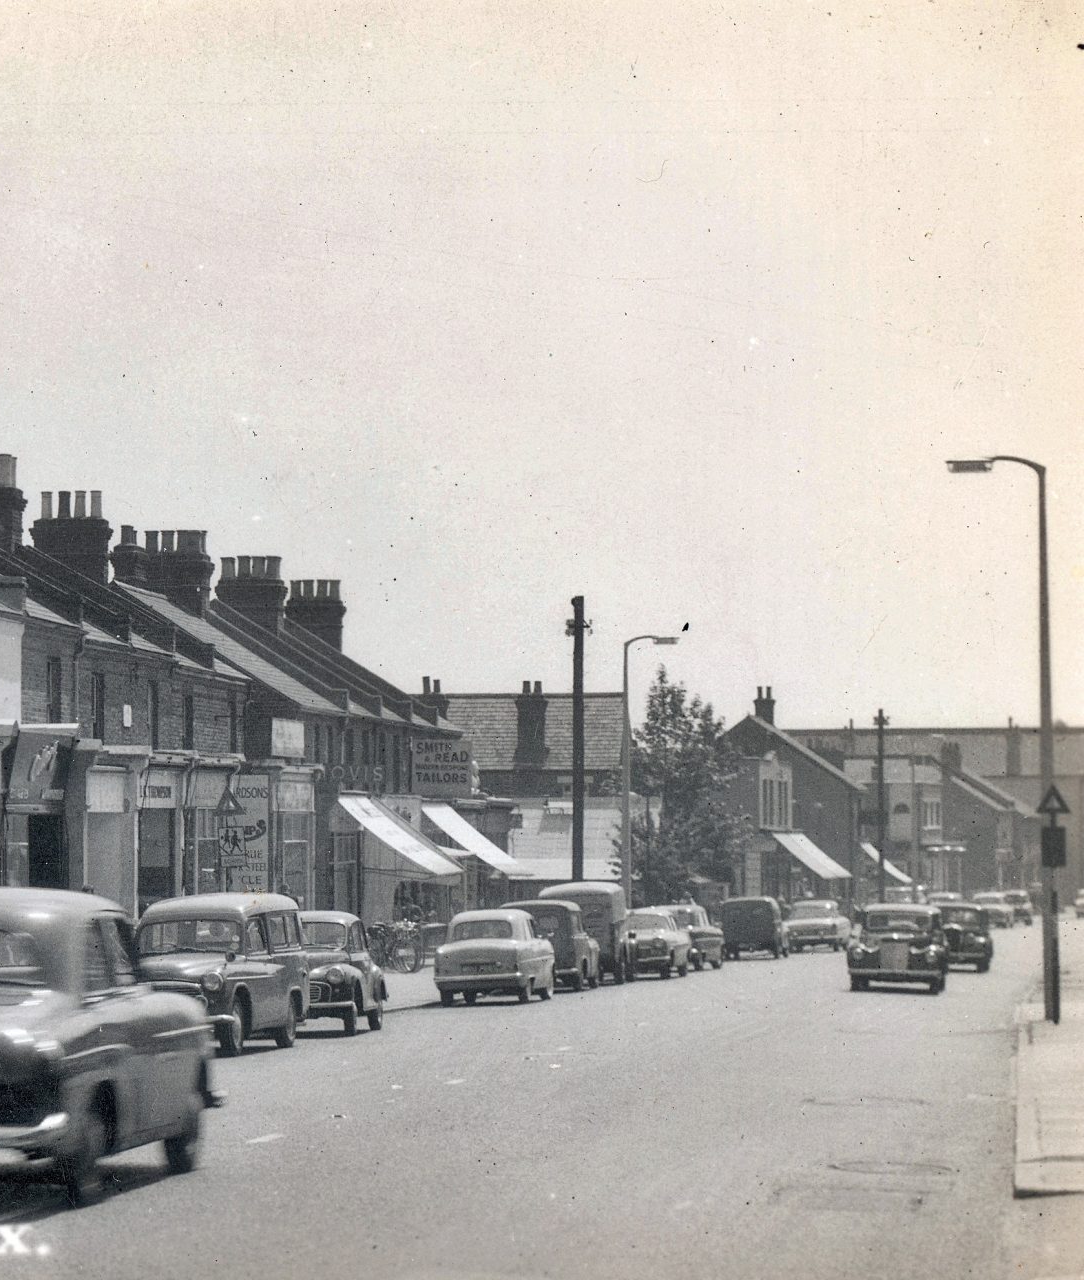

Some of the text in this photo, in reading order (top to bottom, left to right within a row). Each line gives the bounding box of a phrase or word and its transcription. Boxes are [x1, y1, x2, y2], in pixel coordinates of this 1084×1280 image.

[416, 742, 452, 754] SMITH
[434, 752, 470, 762] READ
[416, 772, 467, 783] TAILORS
